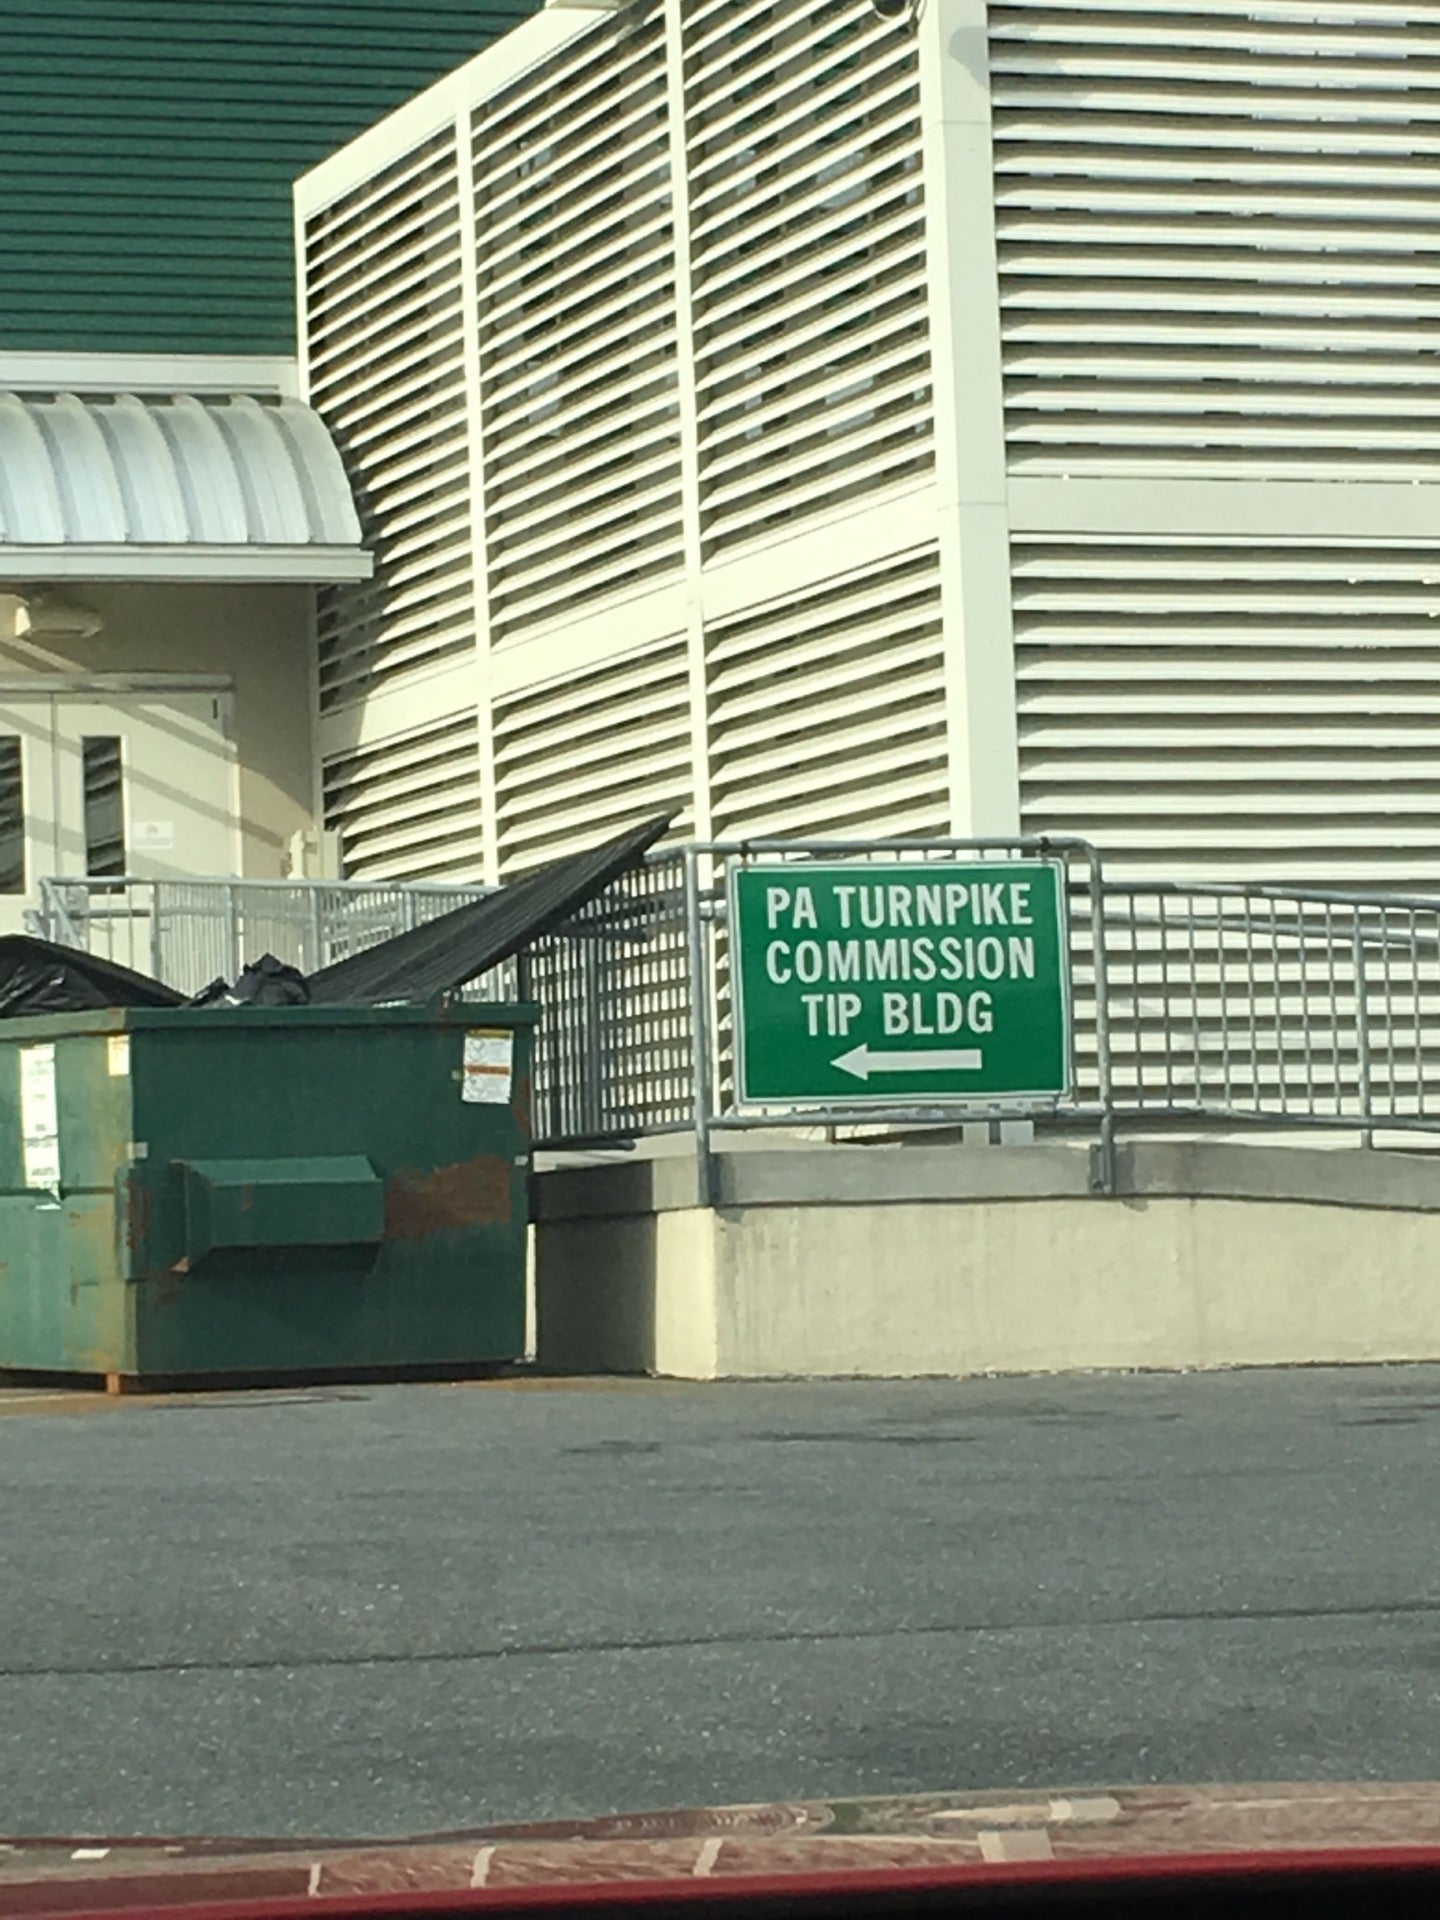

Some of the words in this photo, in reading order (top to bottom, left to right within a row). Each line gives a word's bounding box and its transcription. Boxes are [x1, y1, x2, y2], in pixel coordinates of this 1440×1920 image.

[766, 886, 817, 929] PA
[833, 882, 1034, 929] TURNPIKE
[766, 936, 1035, 984] COMMISSION
[801, 993, 862, 1037] TIP
[882, 990, 994, 1036] BLDG
